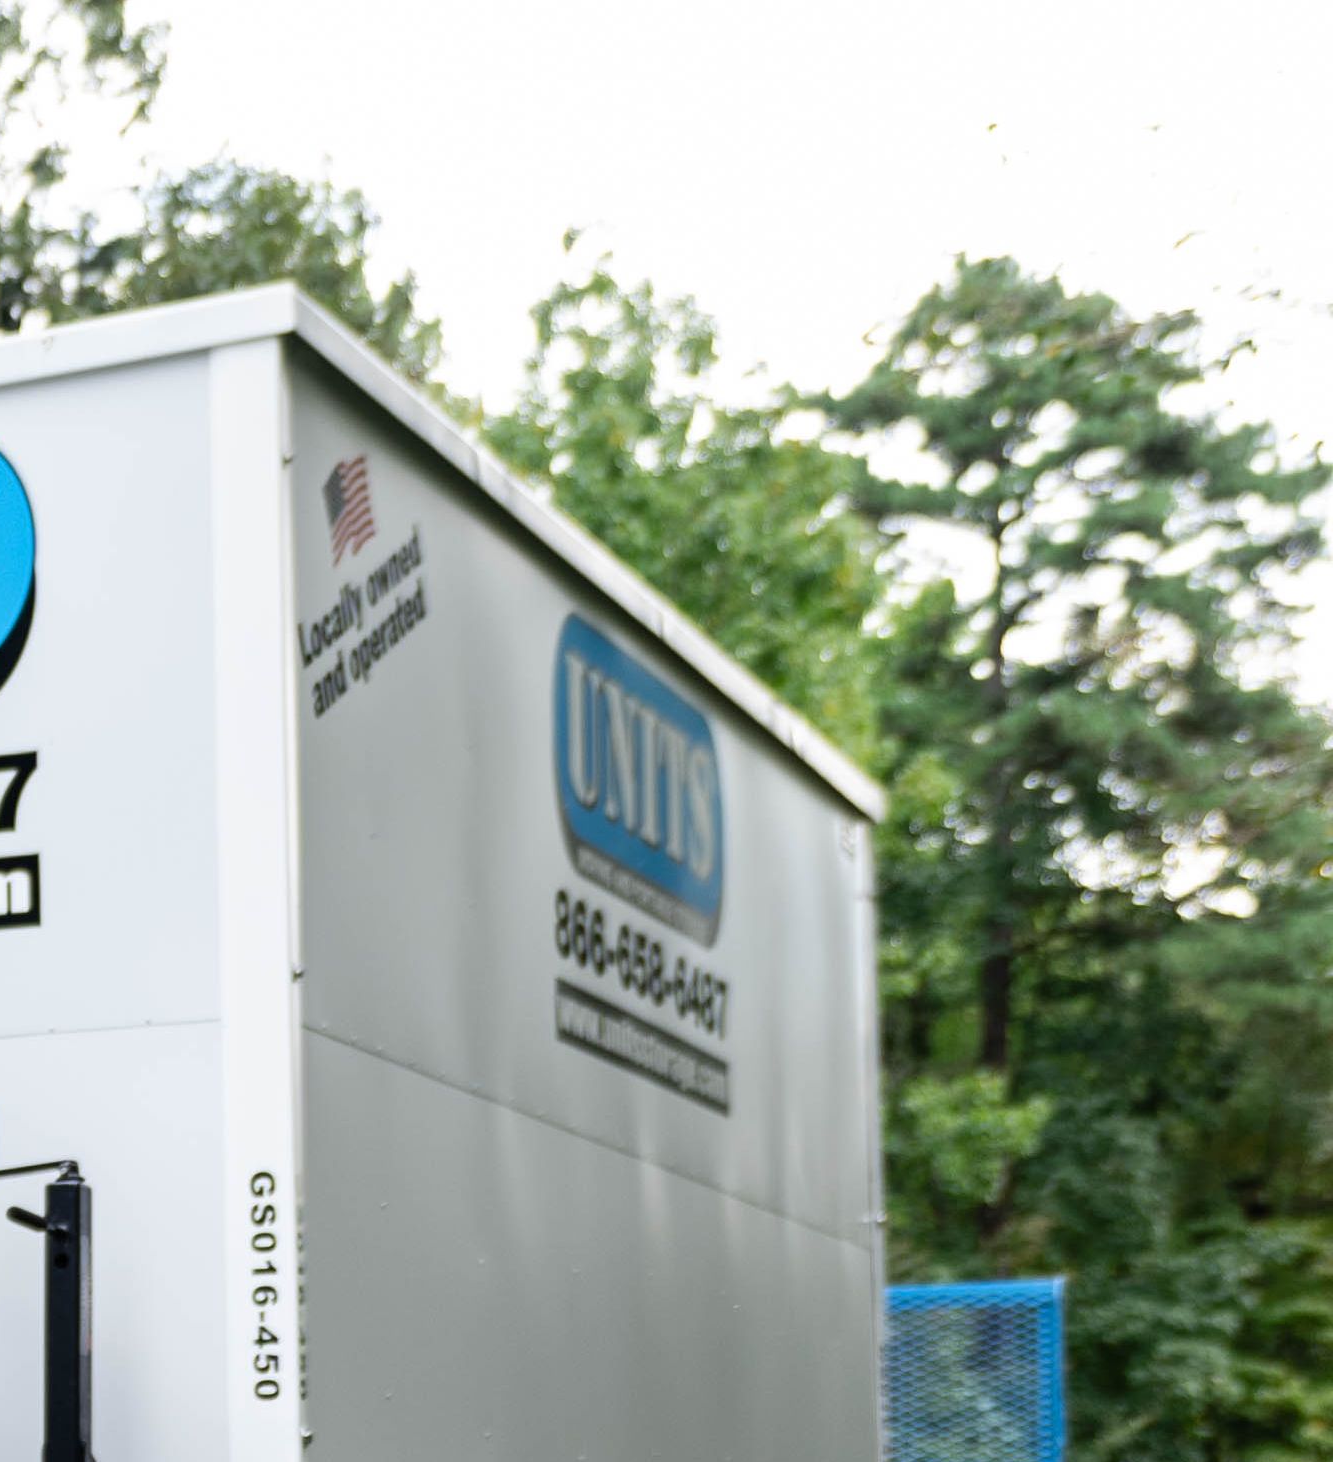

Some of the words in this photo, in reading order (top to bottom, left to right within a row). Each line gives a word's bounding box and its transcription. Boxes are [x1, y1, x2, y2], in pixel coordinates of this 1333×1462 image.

[298, 582, 364, 669] Locally
[367, 525, 423, 606] owned
[312, 648, 349, 719] and
[349, 577, 427, 684] operated
[564, 651, 717, 882] UNITS
[554, 888, 729, 1042] 866-658-6487
[249, 1170, 281, 1402] GS016-450
